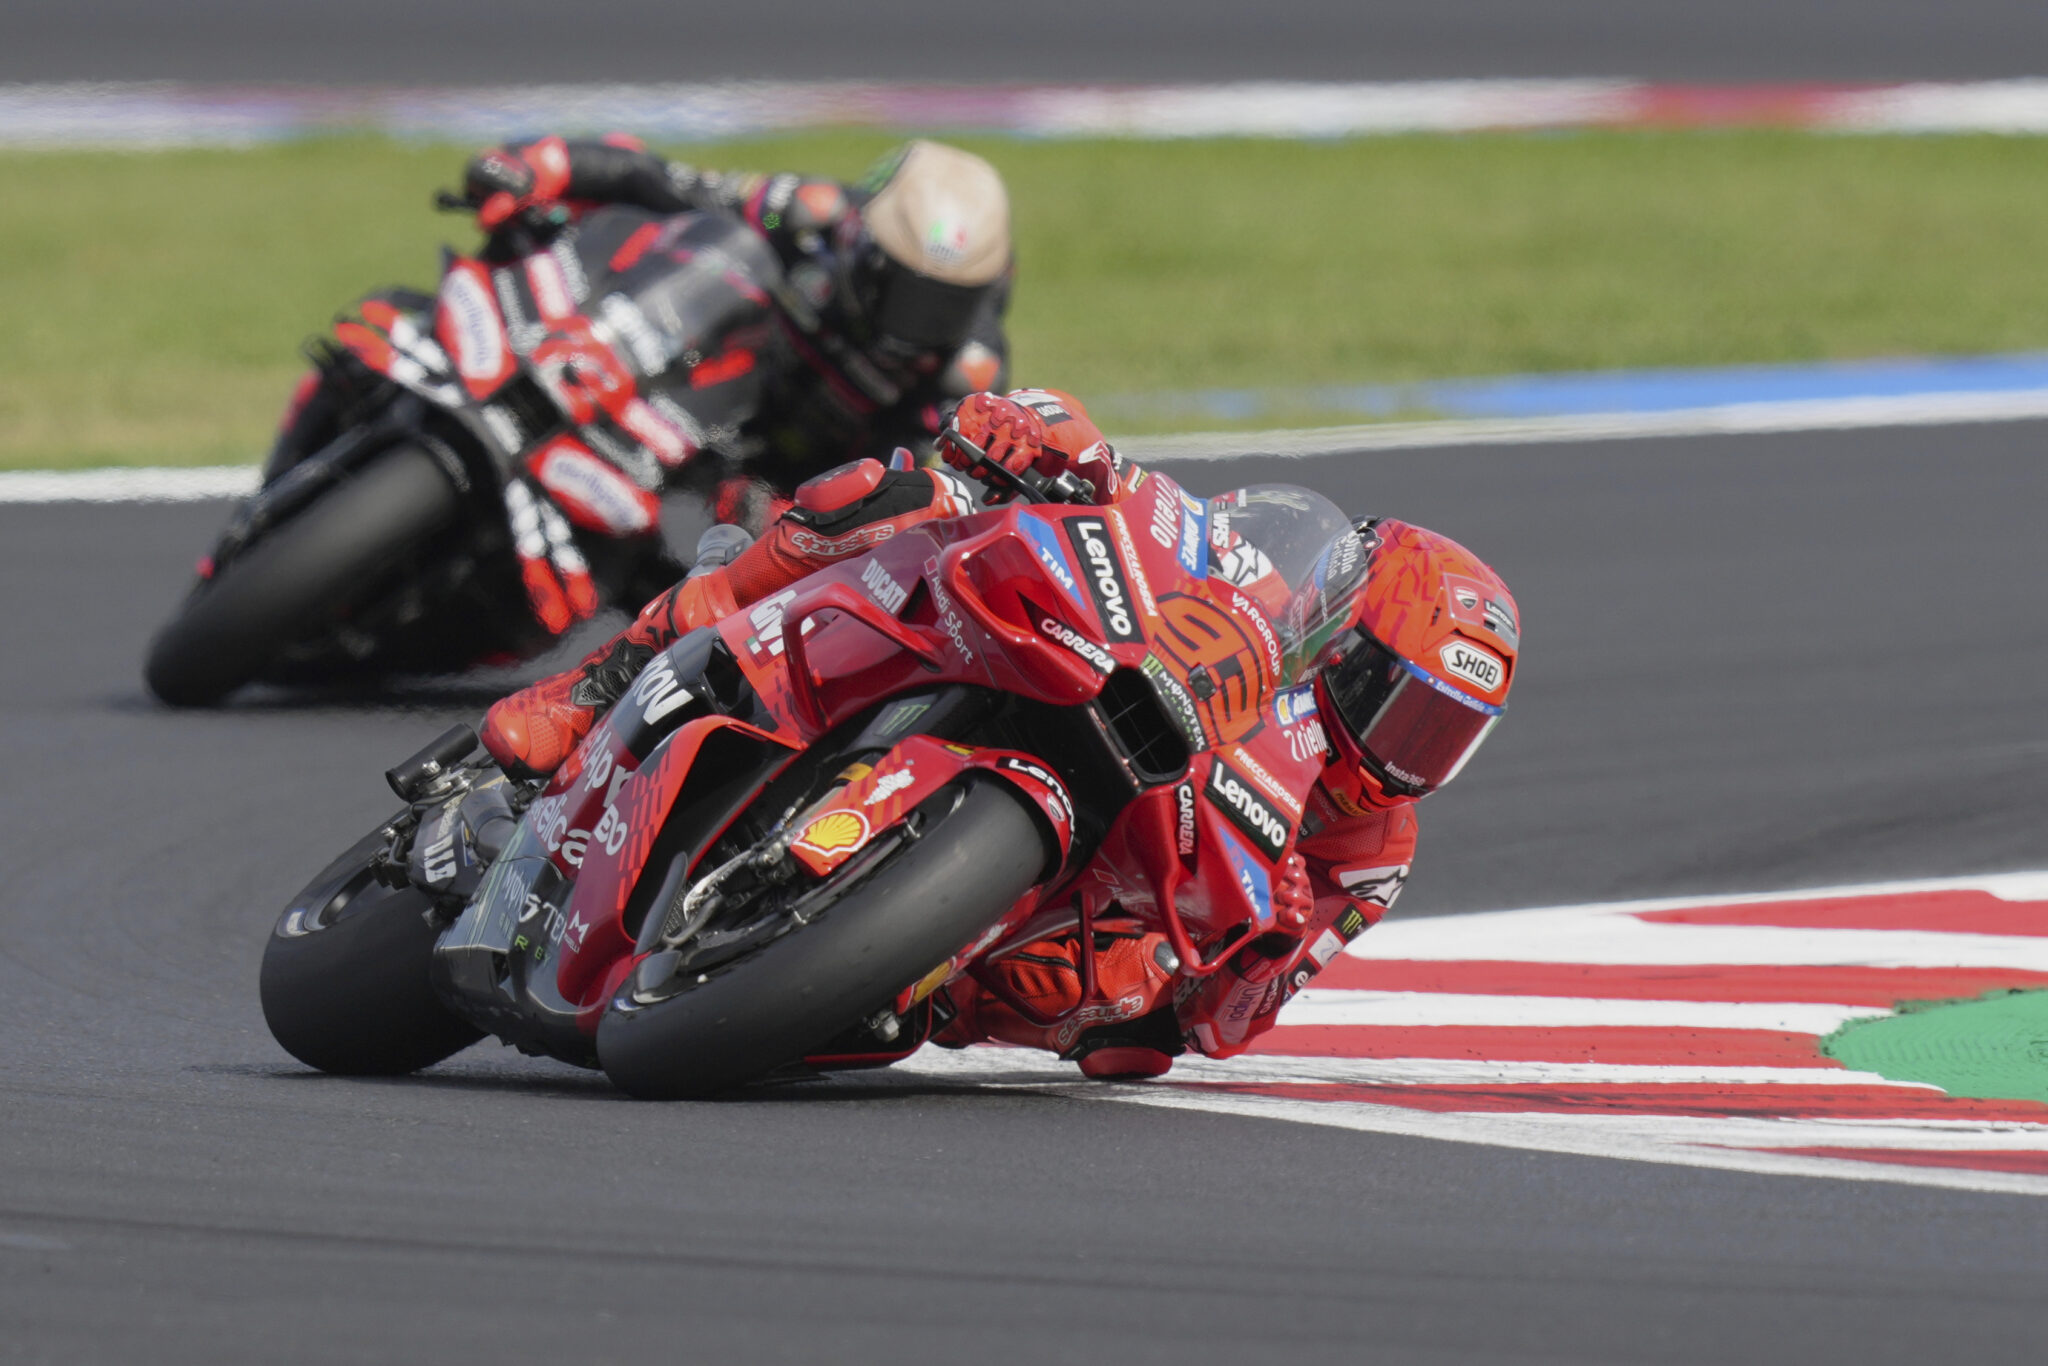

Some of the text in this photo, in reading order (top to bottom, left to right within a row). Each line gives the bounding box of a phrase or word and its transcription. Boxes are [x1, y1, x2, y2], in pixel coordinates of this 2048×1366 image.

[791, 524, 895, 556] alpinestars
[1212, 512, 1230, 548] WRS
[861, 558, 907, 615] DUCATI
[931, 576, 951, 614] Audi
[1040, 546, 1075, 590] TIM
[1077, 521, 1132, 636] Lenovo
[1041, 617, 1115, 674] CARRERA
[1451, 649, 1498, 686] SHOEI
[1160, 672, 1206, 751] MONSTER
[1234, 747, 1302, 815] FRECCIAROSSA
[1384, 761, 1426, 787] Insta360
[1178, 784, 1194, 855] CARRERA
[1212, 762, 1287, 847] Lenovo
